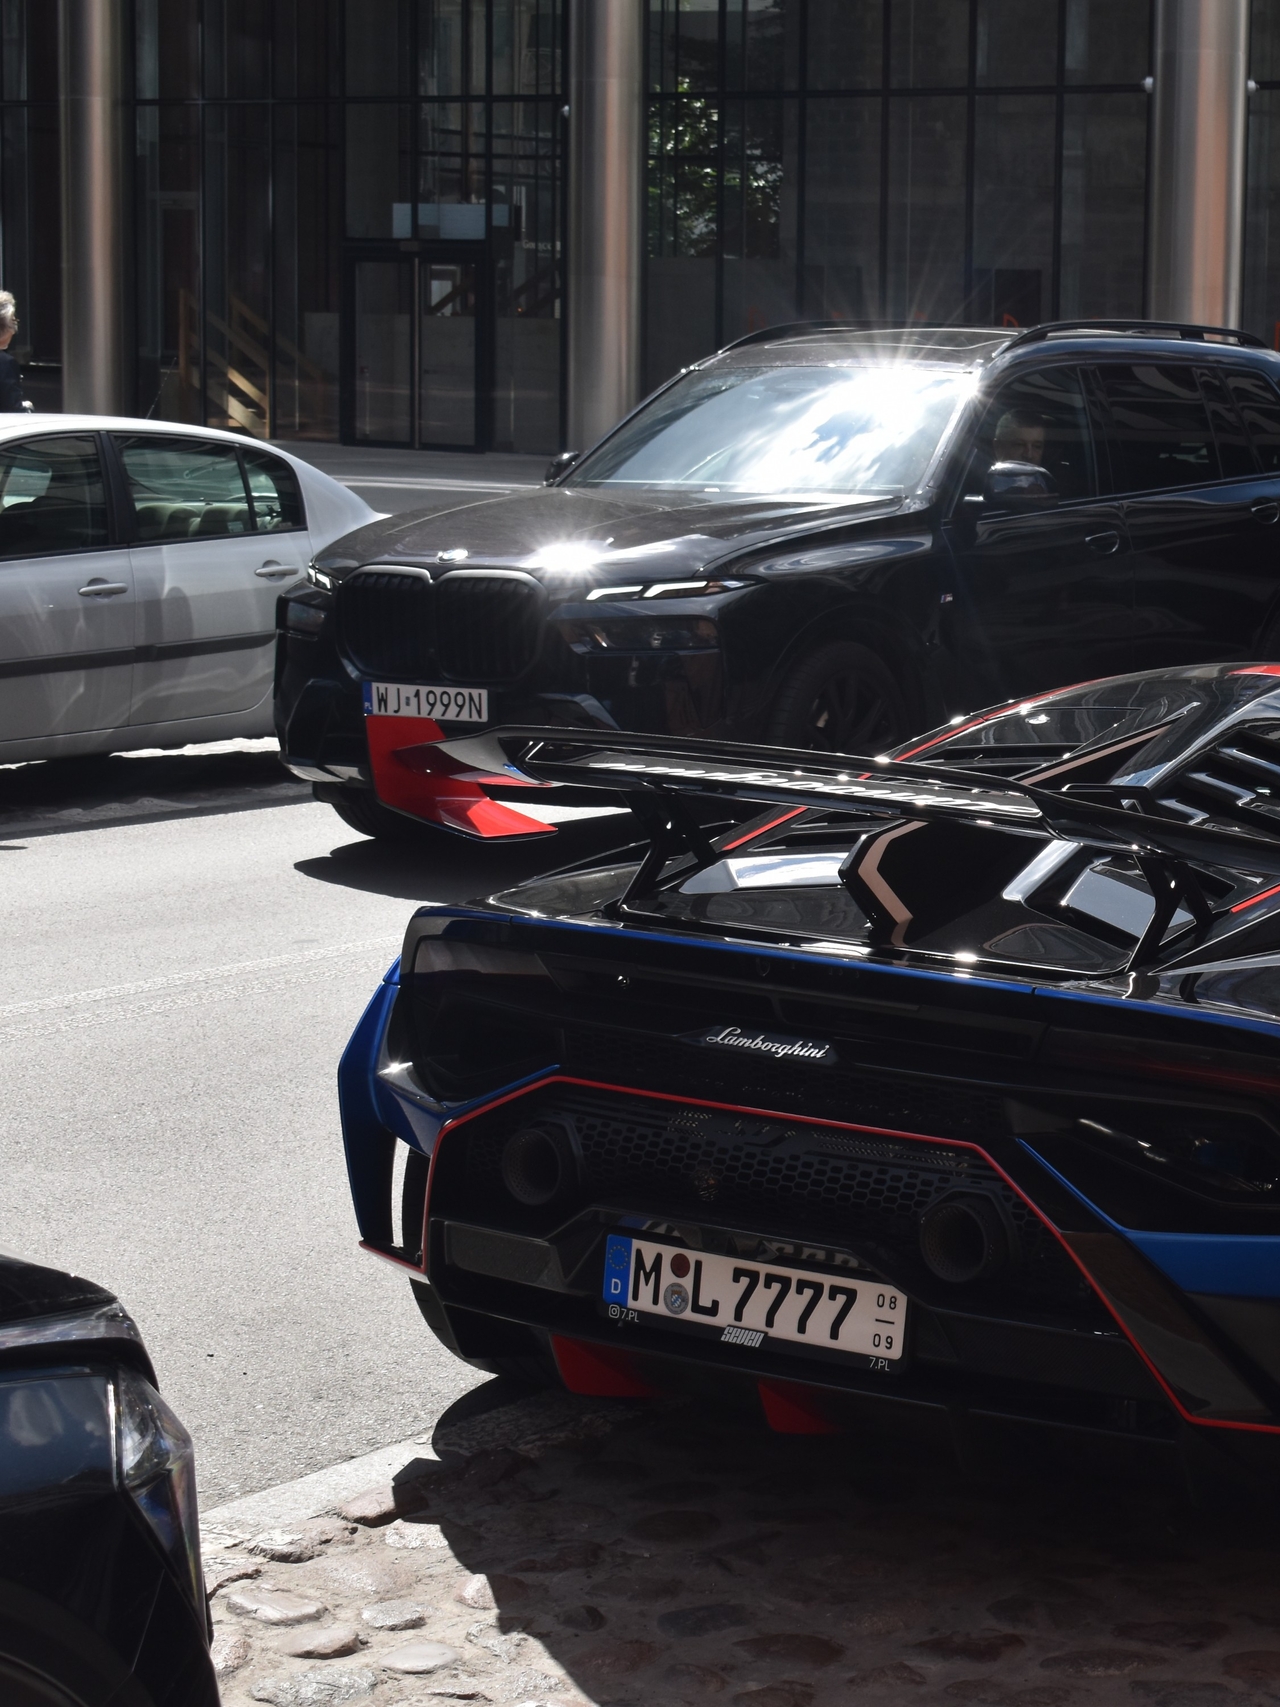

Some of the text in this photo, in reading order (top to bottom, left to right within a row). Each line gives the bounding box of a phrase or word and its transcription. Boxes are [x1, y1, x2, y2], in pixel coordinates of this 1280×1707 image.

[376, 686, 482, 720] WJ 1999N
[706, 1026, 830, 1059] Lamborghini
[610, 1278, 621, 1294] D
[632, 1248, 663, 1306] M
[690, 1259, 720, 1318] L
[732, 1266, 858, 1341] 7777
[876, 1293, 898, 1311] 08
[872, 1333, 894, 1350] 09
[869, 1356, 891, 1372] 7.PL
